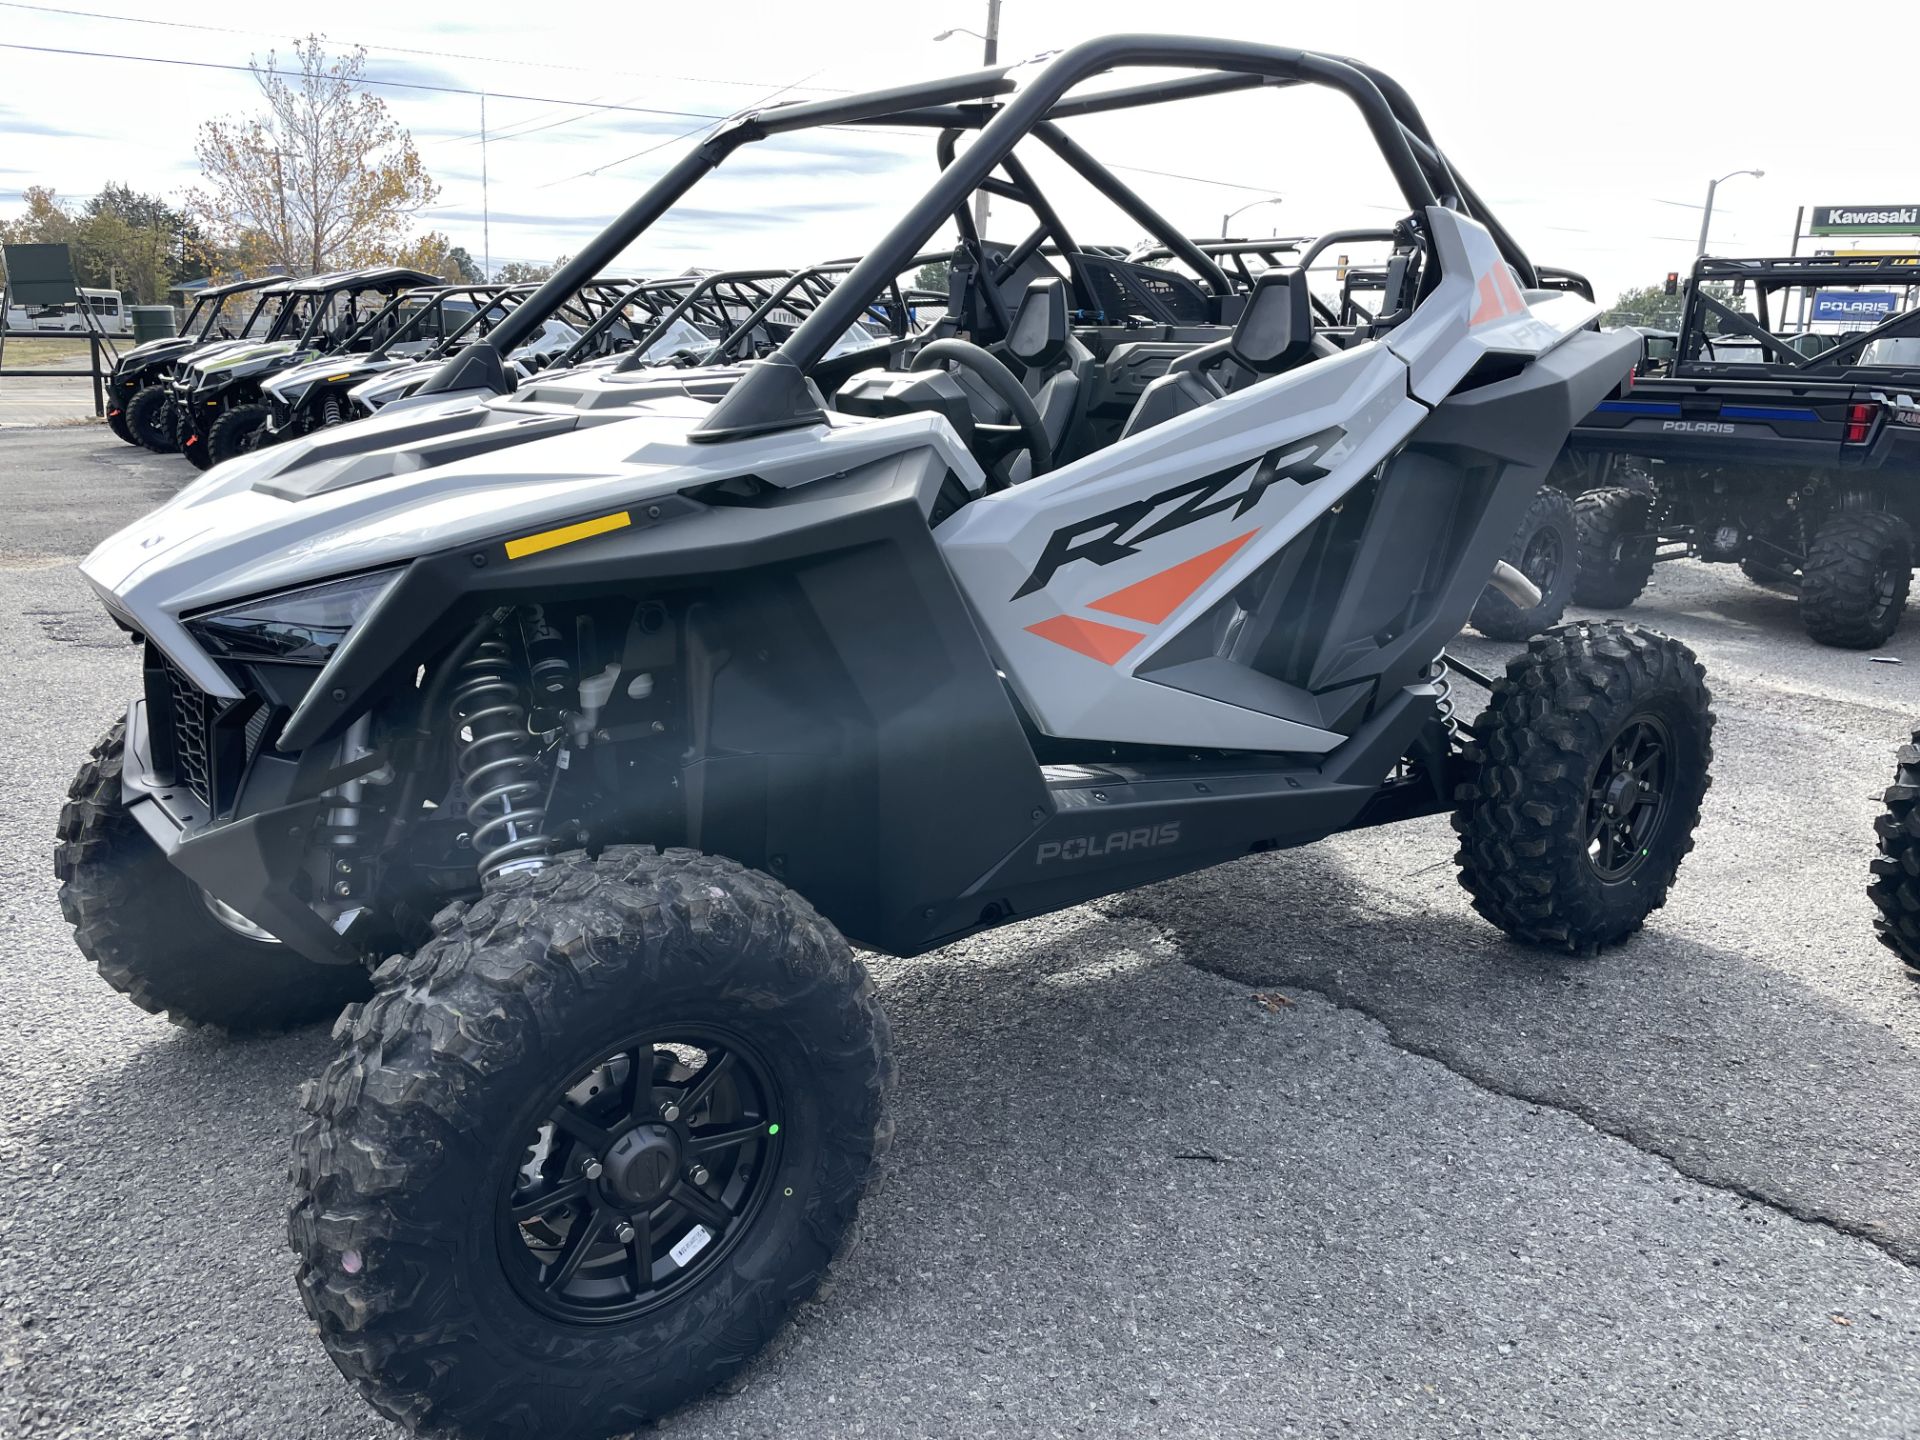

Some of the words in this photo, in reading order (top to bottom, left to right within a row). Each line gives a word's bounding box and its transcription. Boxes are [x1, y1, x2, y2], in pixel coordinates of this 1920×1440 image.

[1828, 208, 1918, 224] Kawasaki
[1819, 301, 1889, 312] POLARIS
[1662, 420, 1736, 434] POLARIS
[1009, 424, 1348, 603] RZR
[1035, 820, 1182, 865] POLARIS
